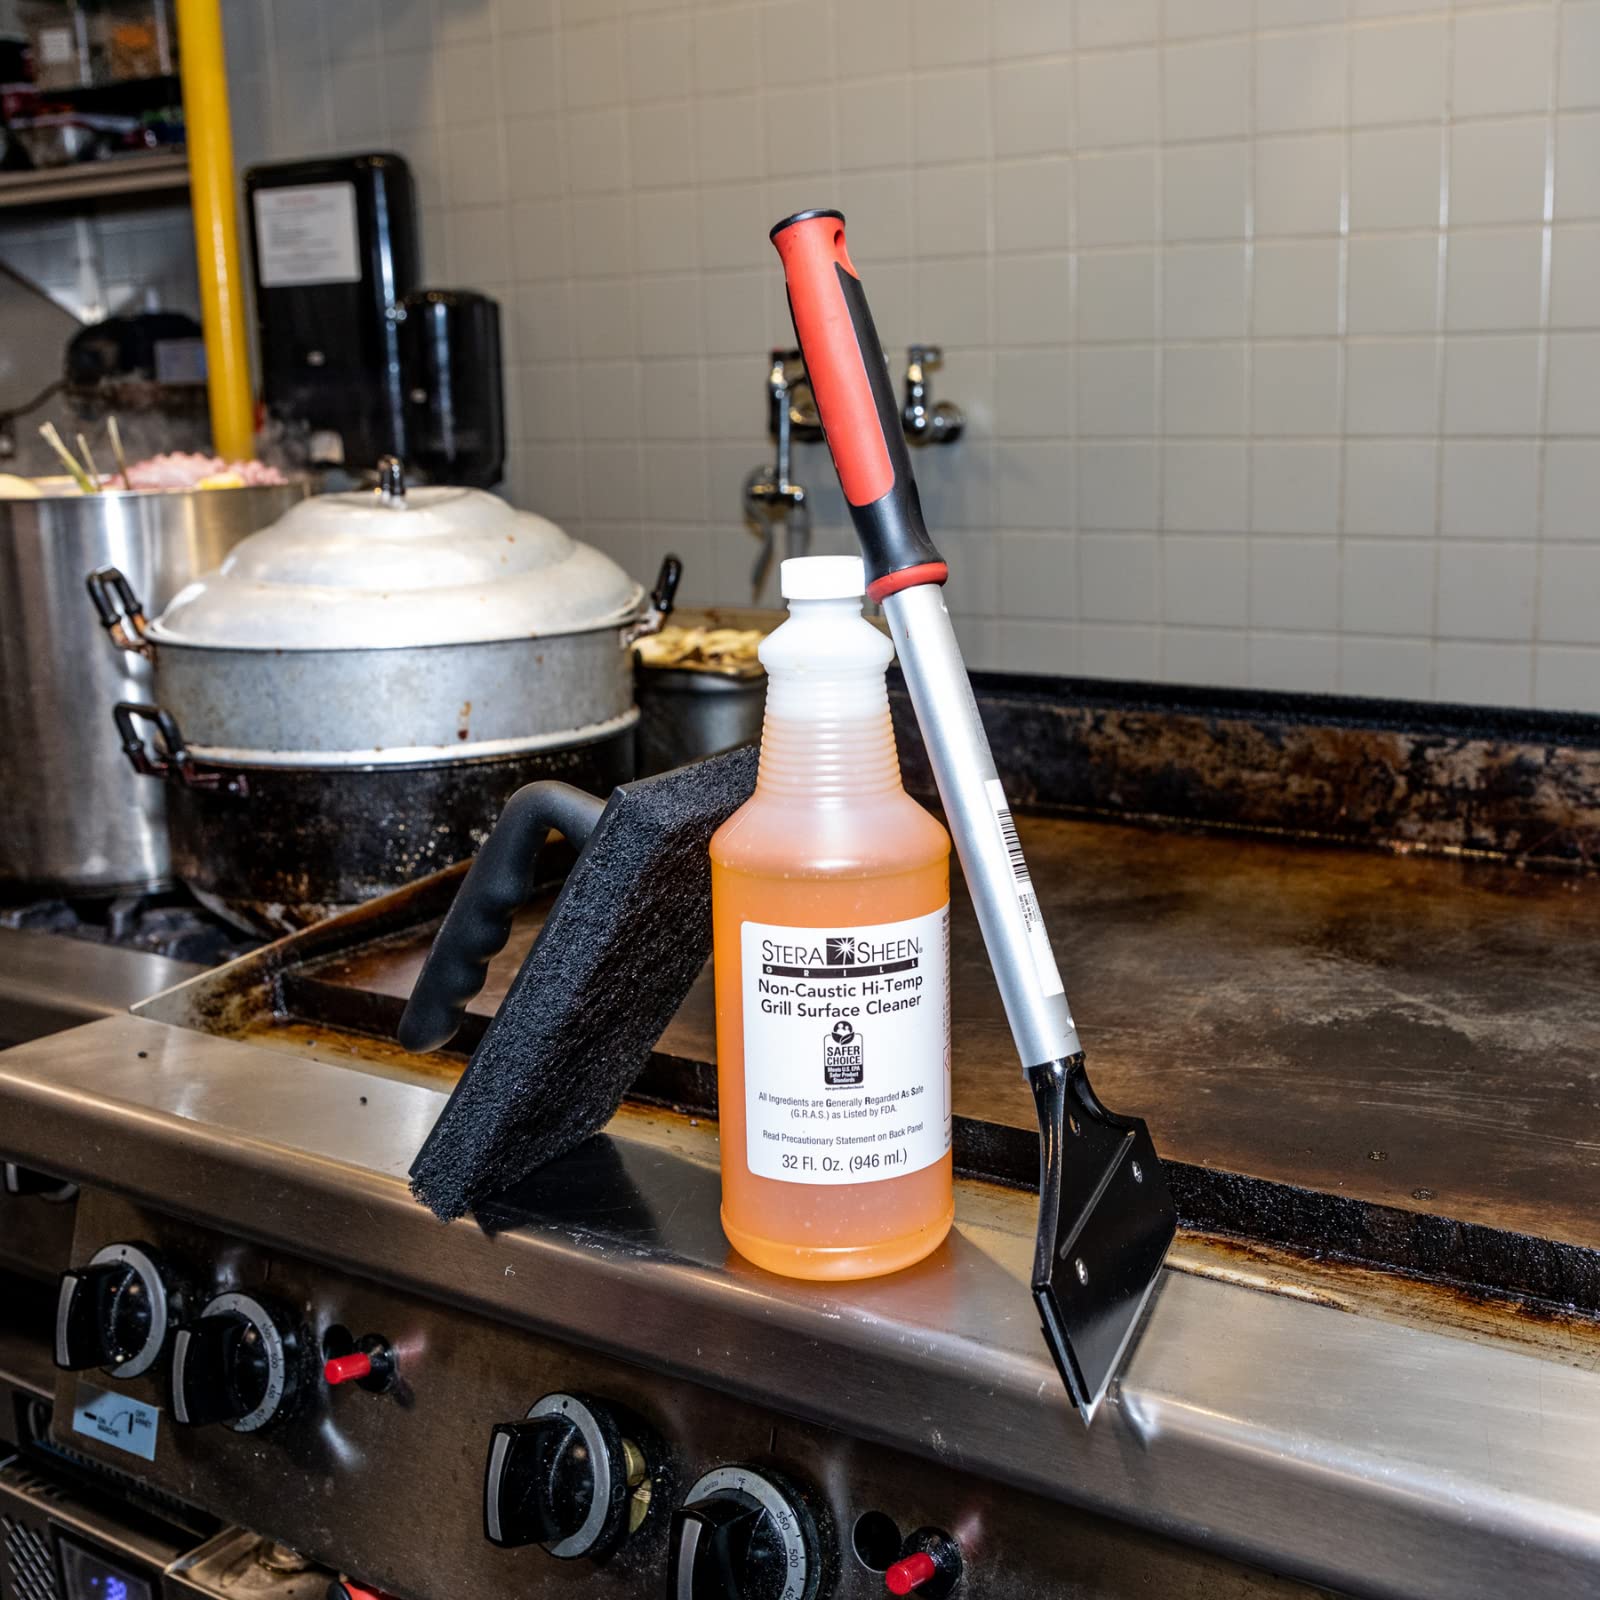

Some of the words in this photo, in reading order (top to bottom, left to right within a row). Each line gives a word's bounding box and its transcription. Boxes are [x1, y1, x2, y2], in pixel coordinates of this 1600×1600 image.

[765, 960, 916, 977] GRILL
[758, 978, 857, 998] Non-Caustic
[862, 975, 923, 996] Hi-Temp
[761, 998, 792, 1016] Grill
[797, 1002, 860, 1018] Surface
[866, 994, 922, 1015] Cleaner
[826, 1045, 860, 1057] SAFER
[826, 1055, 861, 1066] CHOICE
[758, 1091, 767, 1101] All
[768, 1093, 810, 1108] Ingredients
[811, 1100, 824, 1108] are
[825, 1097, 863, 1109] Generally
[864, 1091, 900, 1105] Regarded
[900, 1089, 910, 1099] As
[910, 1085, 924, 1096] Safe
[790, 1109, 830, 1121] (G.R.A.S.)
[831, 1111, 841, 1120] as
[843, 1108, 867, 1119] Listed
[869, 1106, 879, 1117] by
[762, 1130, 780, 1141] Read
[781, 1134, 834, 1147] Precautionary
[835, 1133, 876, 1145] Statement
[877, 1131, 887, 1140] on
[888, 1128, 906, 1139] Back
[906, 1121, 924, 1135] Panel
[782, 1154, 798, 1170] 32
[802, 1156, 817, 1171] Fl.
[822, 1156, 844, 1172] Oz.
[849, 1153, 880, 1173] (946
[884, 1147, 907, 1166] ml.)
[776, 1511, 790, 1531] 550
[788, 1548, 799, 1568] 500
